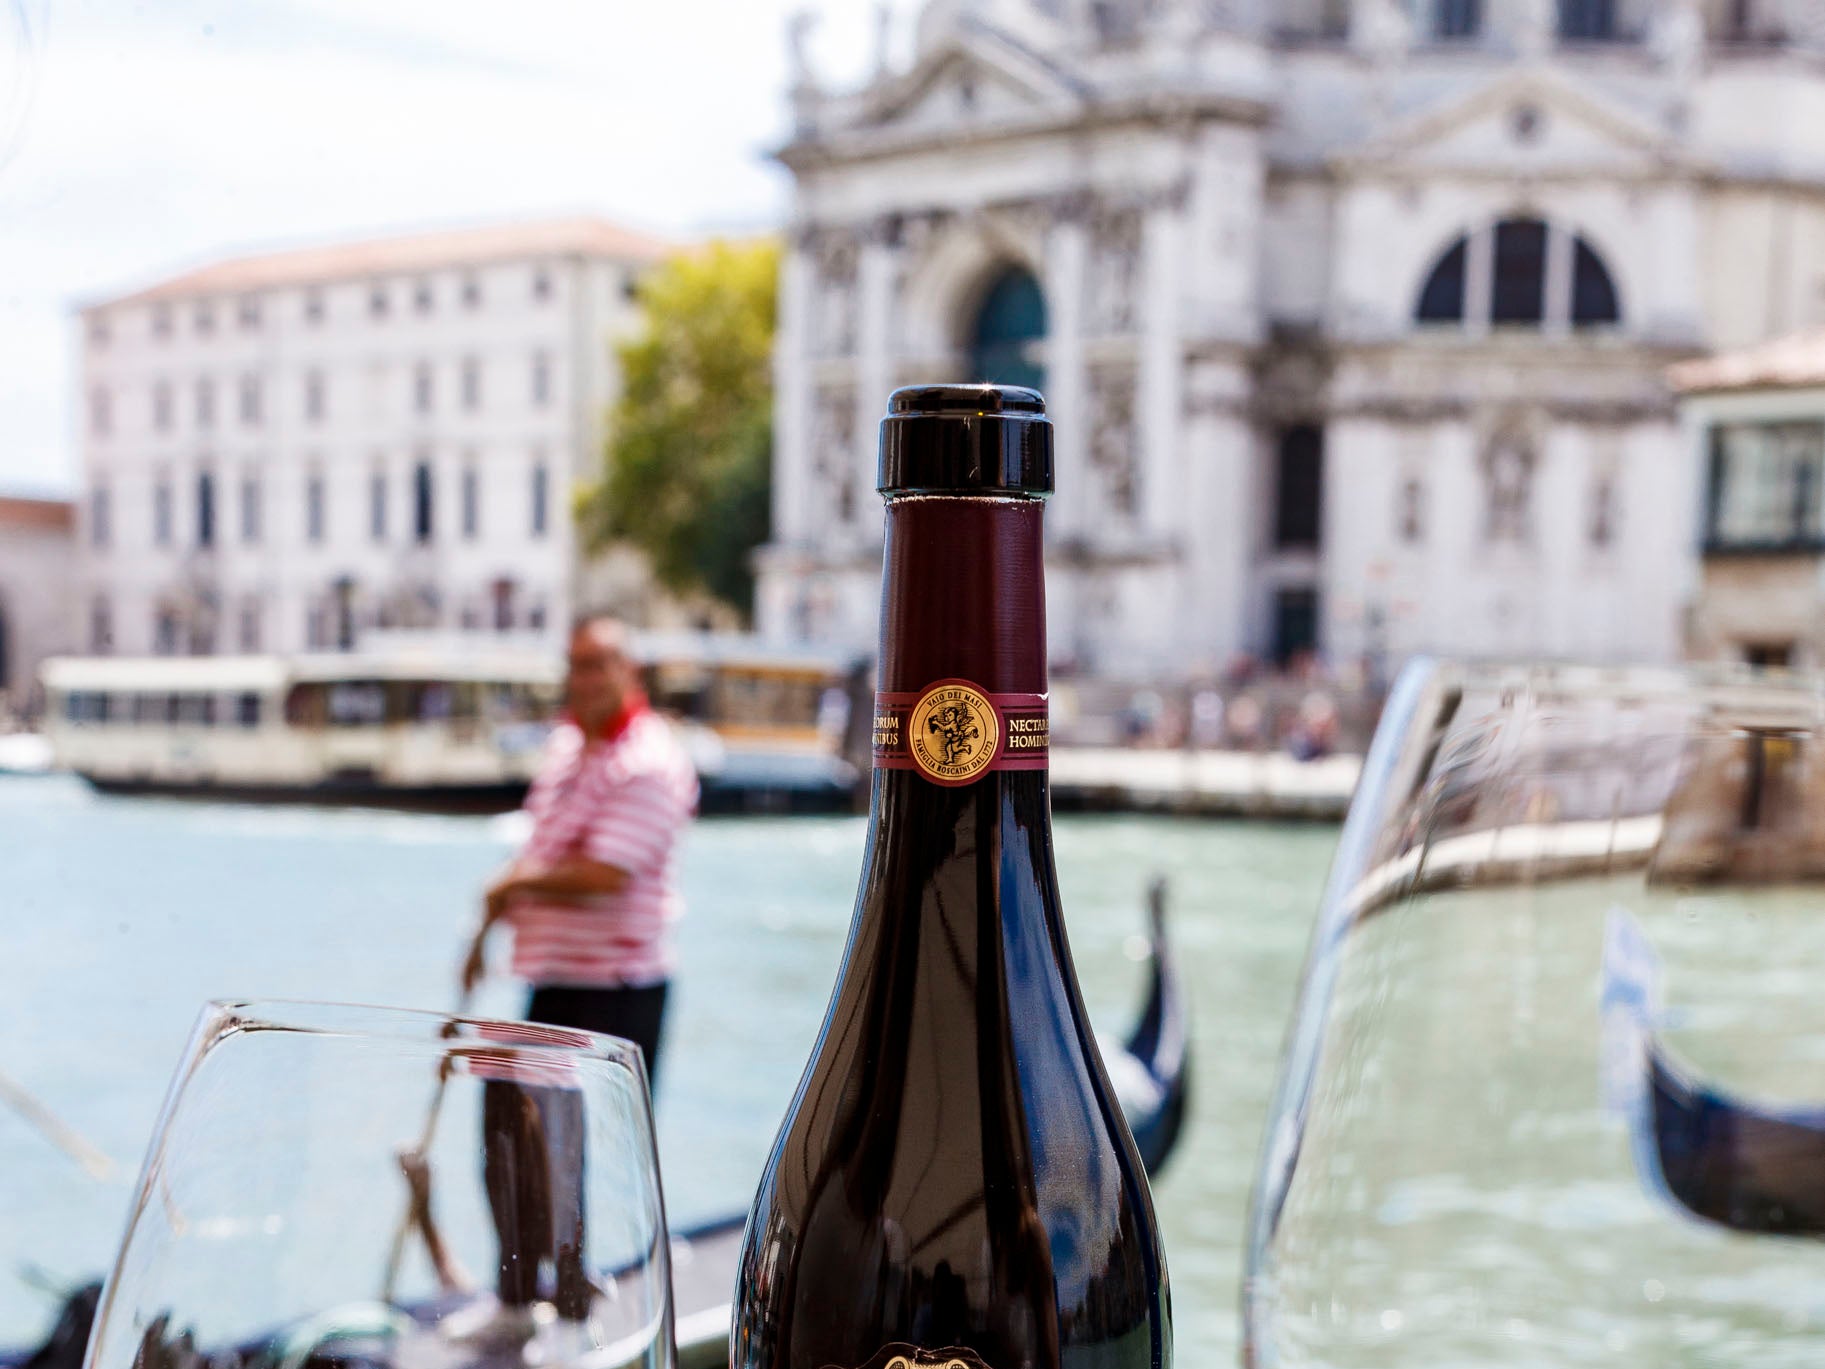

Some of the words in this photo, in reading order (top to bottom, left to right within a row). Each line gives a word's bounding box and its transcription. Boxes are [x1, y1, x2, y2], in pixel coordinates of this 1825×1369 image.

[927, 694, 945, 708] VAIO
[947, 691, 962, 699] DEI
[963, 693, 983, 709] MASI
[915, 738, 937, 768] FAMIGLIA
[936, 764, 971, 775] BOSCAINI
[970, 756, 985, 769] DAL
[982, 740, 993, 757] 1772
